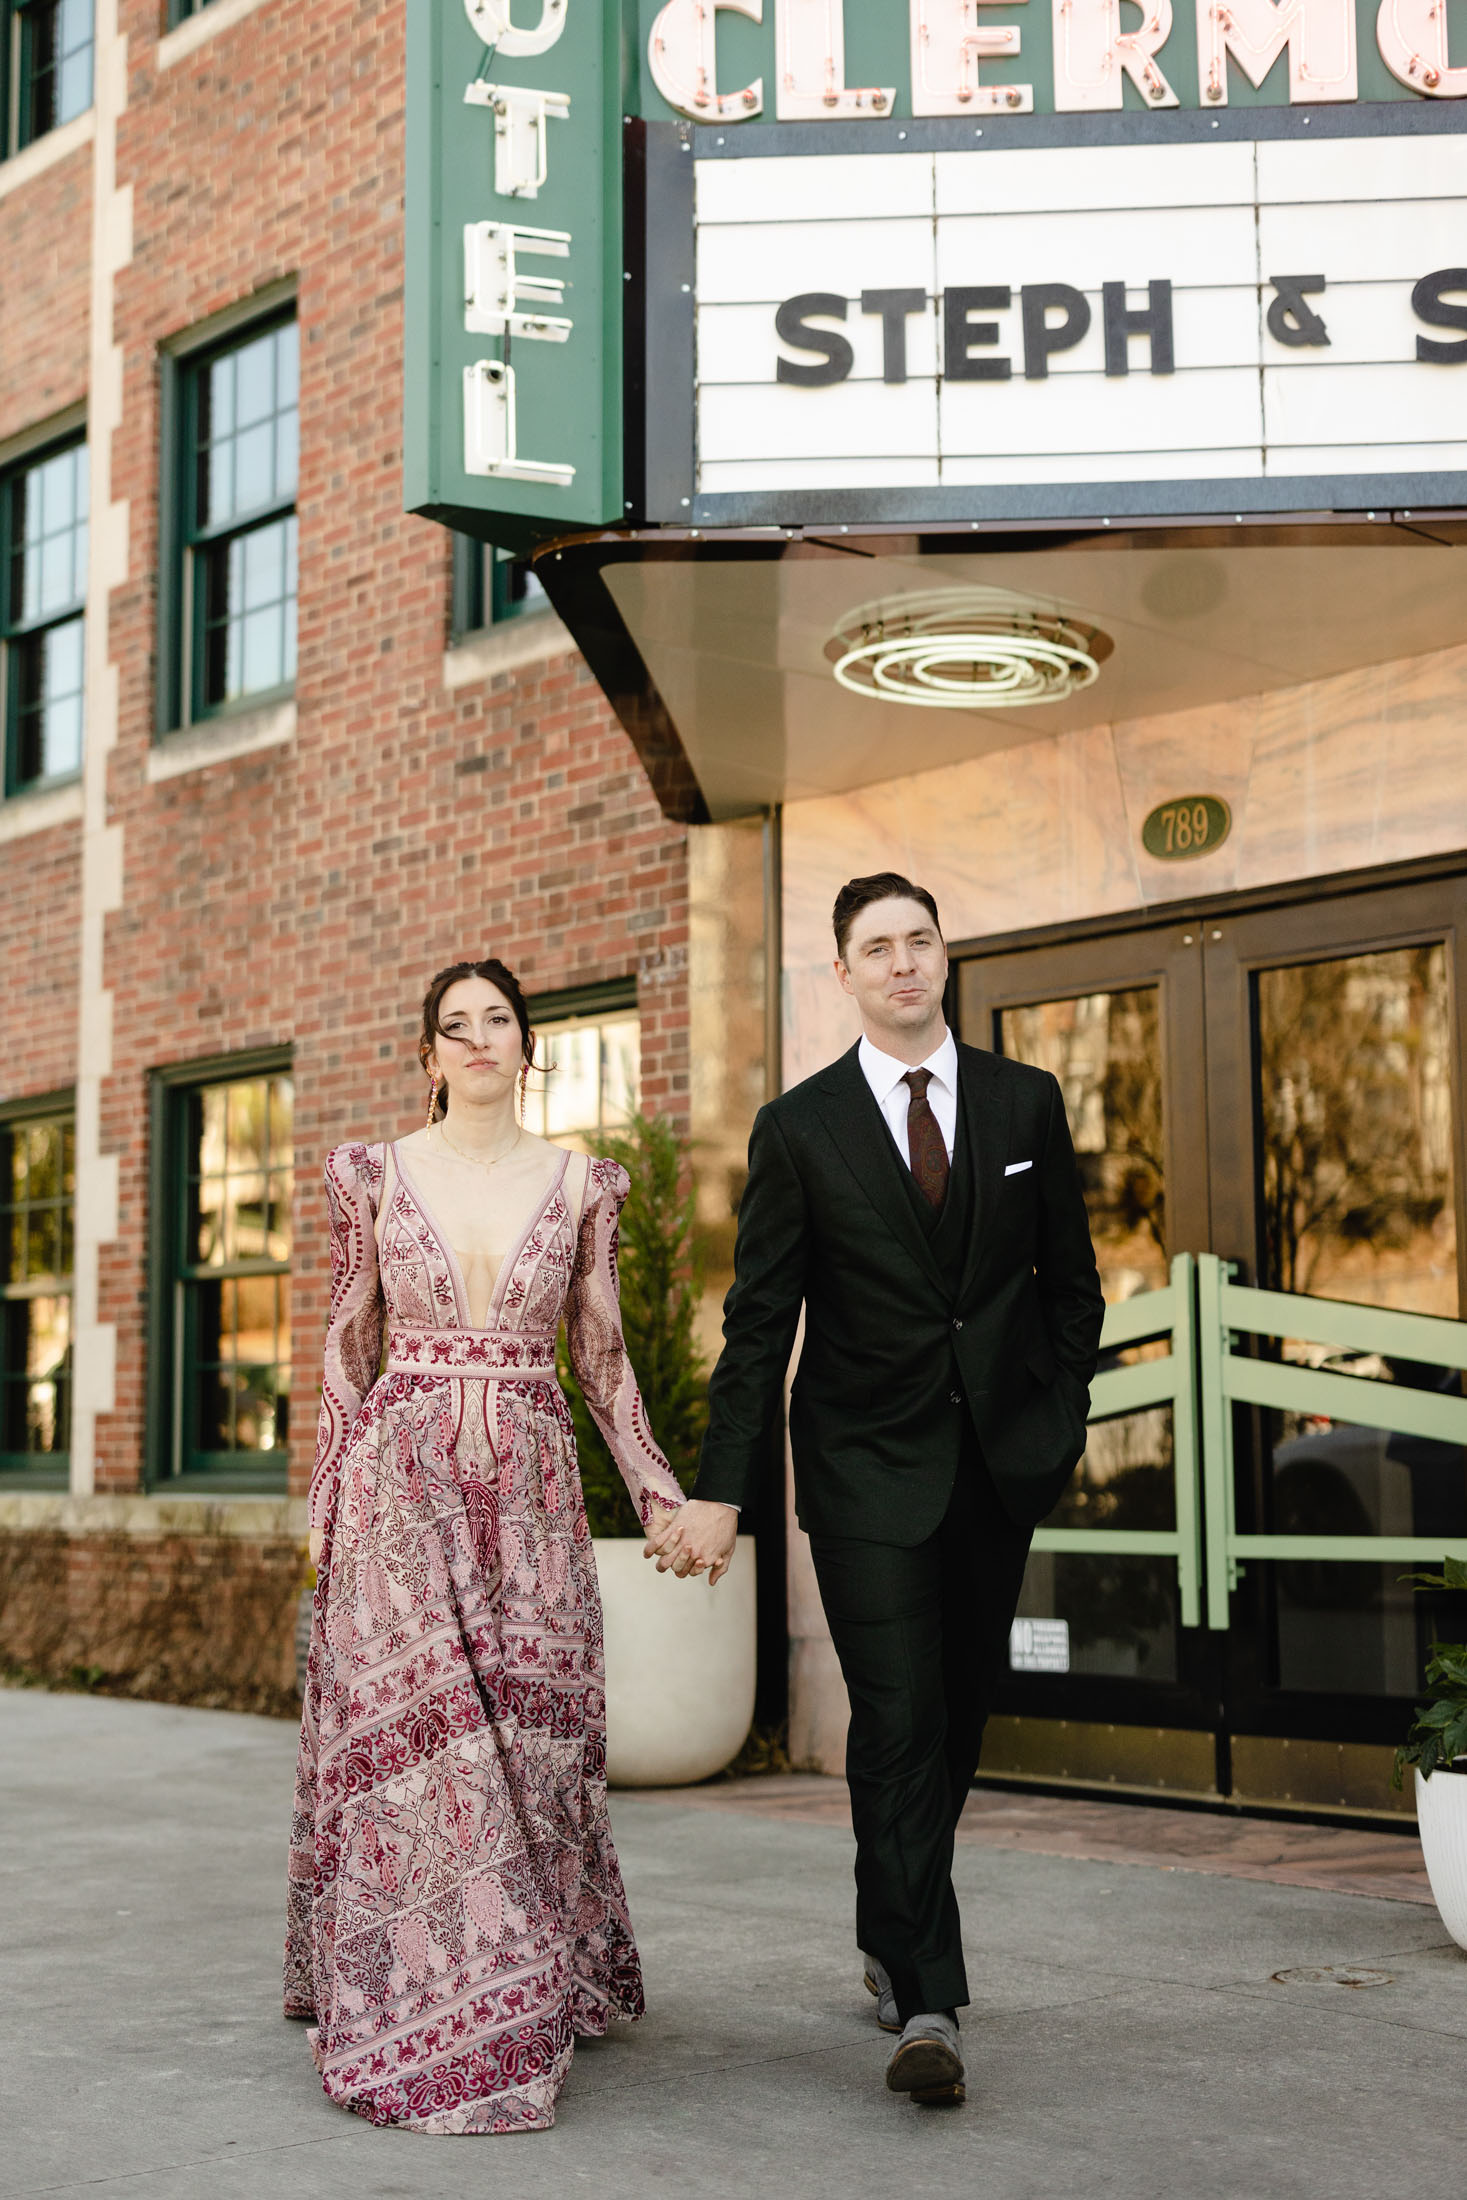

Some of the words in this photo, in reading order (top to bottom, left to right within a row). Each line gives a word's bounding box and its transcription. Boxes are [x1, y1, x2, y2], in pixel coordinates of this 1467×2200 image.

[775, 279, 1175, 387] STEPH
[1267, 274, 1331, 347] &
[1411, 268, 1467, 364] S
[1161, 803, 1208, 852] 789
